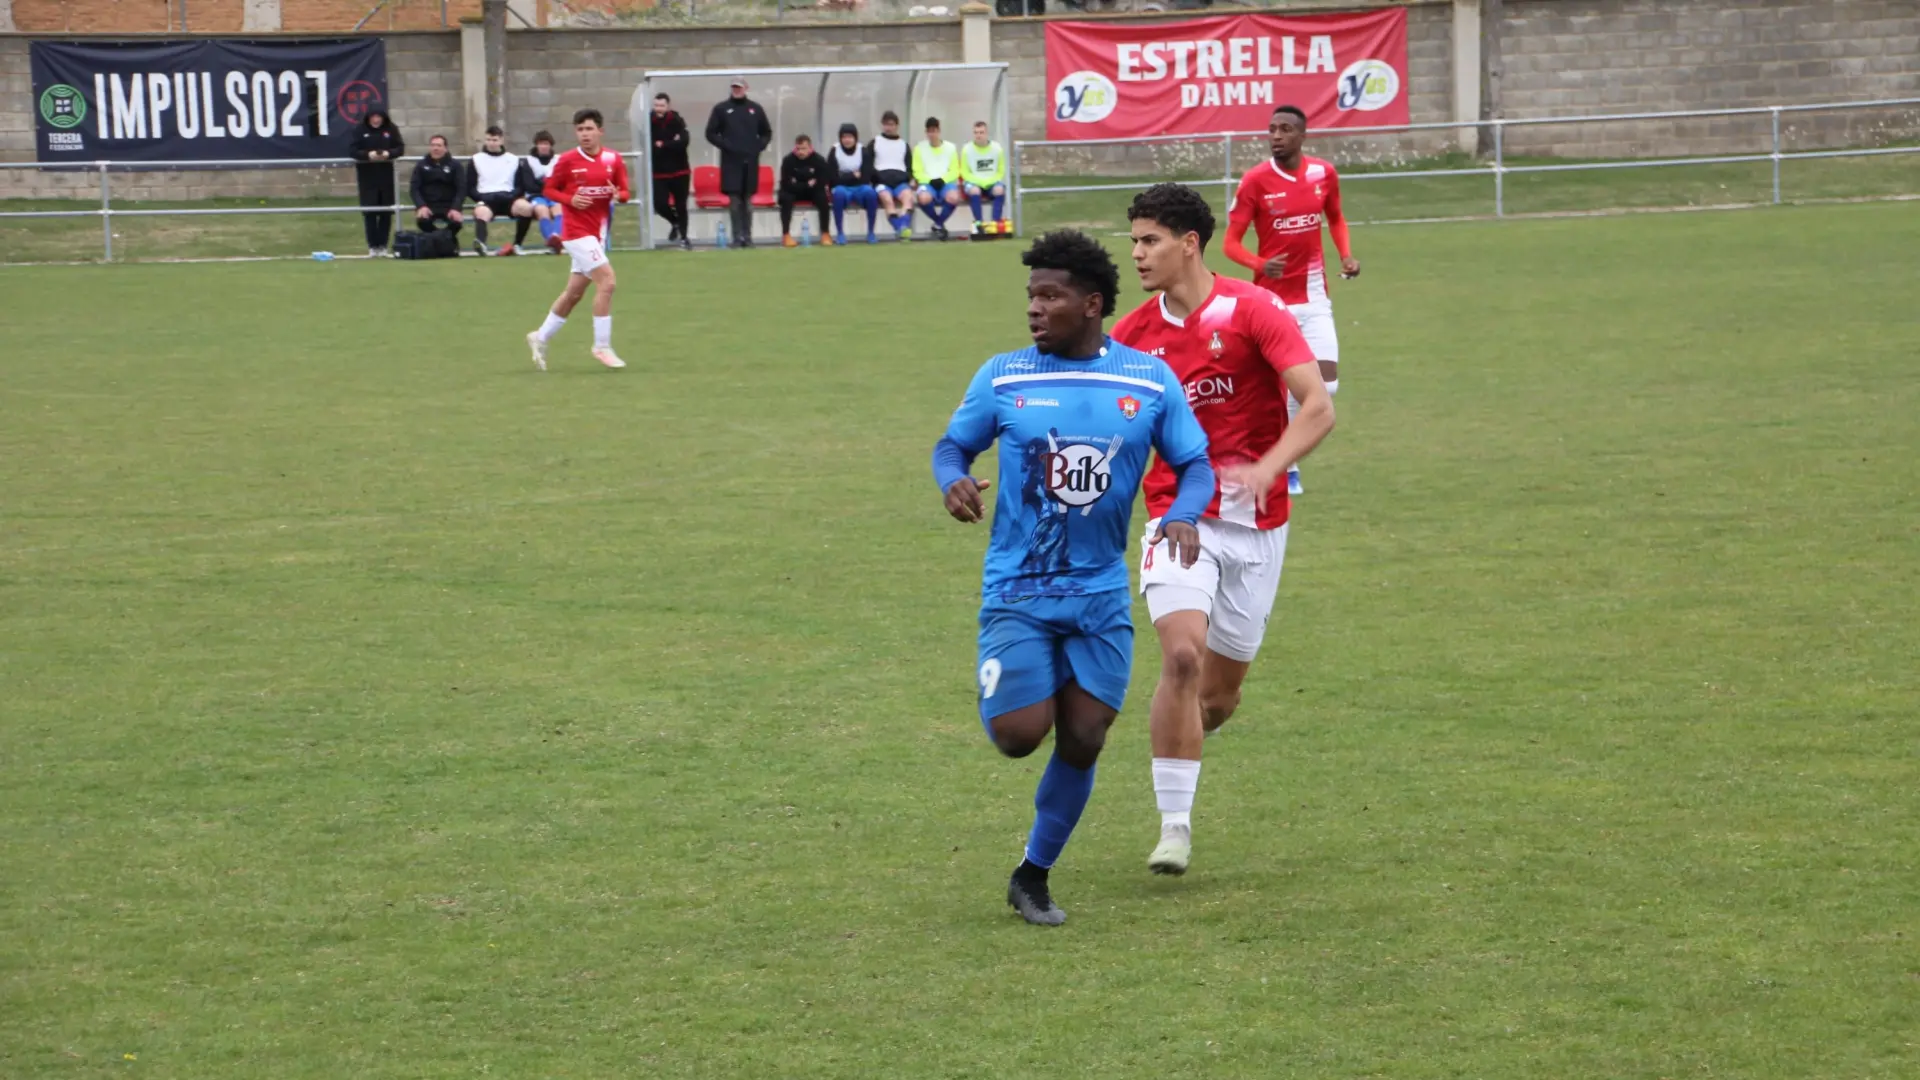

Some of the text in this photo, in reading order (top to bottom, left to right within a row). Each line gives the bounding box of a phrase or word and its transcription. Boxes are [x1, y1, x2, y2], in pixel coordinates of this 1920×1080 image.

[1116, 35, 1337, 81] ESTRELLA
[1181, 80, 1274, 108] DAMM
[1183, 377, 1234, 402] EON
[980, 657, 1002, 699] 9
